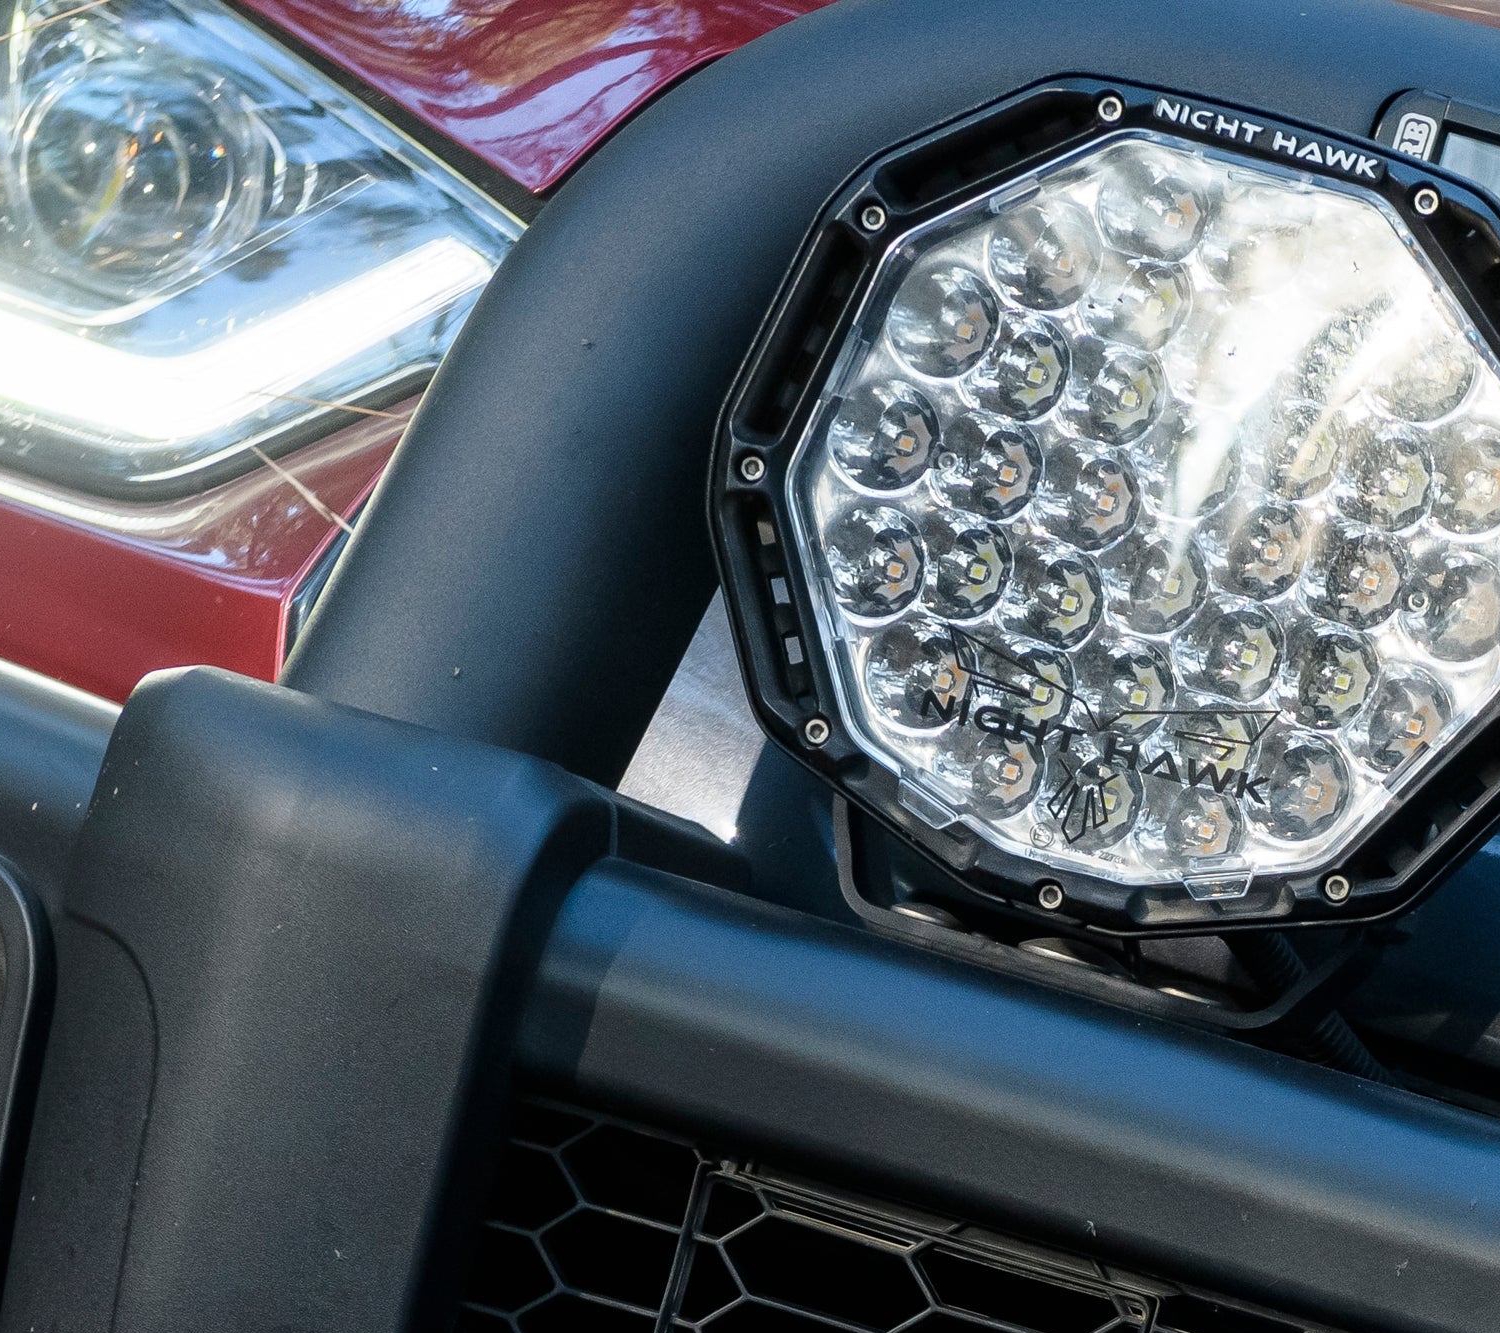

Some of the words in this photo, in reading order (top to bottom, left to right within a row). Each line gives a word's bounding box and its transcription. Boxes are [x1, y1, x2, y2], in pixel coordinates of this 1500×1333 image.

[1272, 130, 1378, 180] HAWK
[1398, 121, 1430, 160] RB
[919, 688, 1088, 753] NIGHT
[1104, 731, 1271, 805] HAWK
